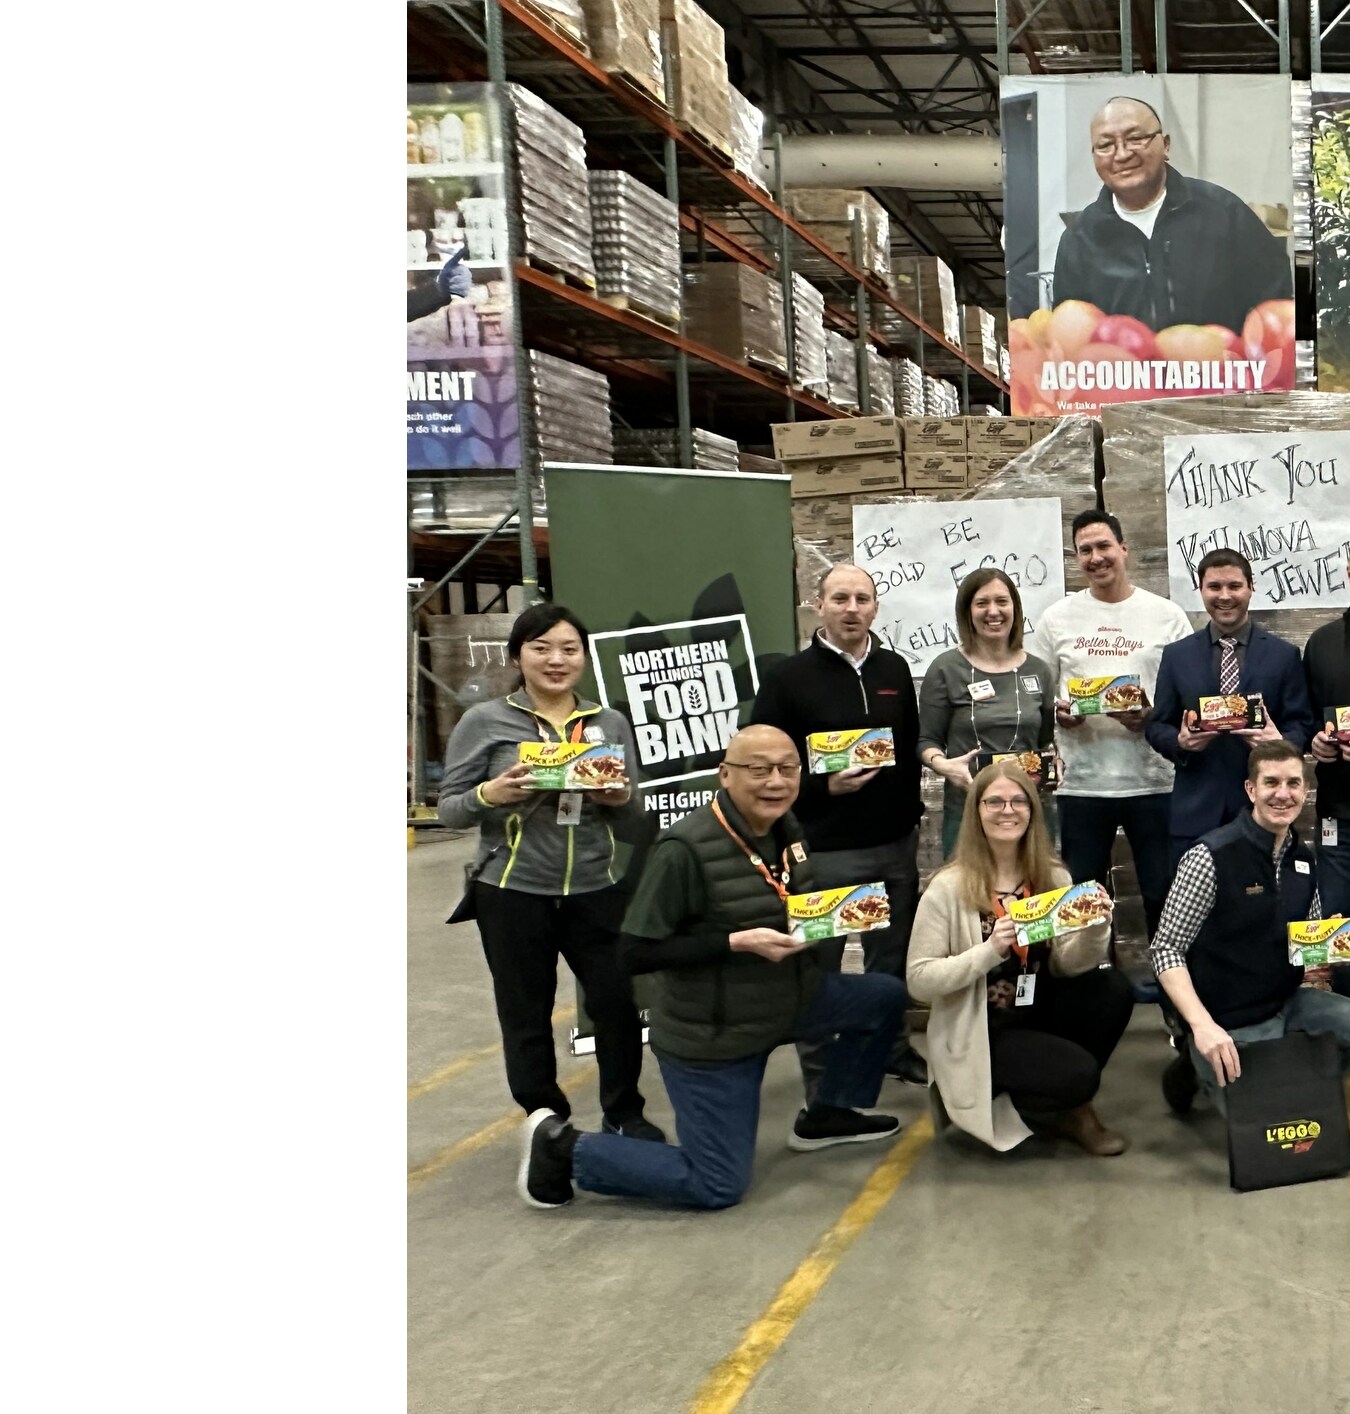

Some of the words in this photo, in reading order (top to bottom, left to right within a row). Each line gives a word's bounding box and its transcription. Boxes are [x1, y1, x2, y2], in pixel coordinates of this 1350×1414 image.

[407, 371, 476, 400] MENT
[1041, 360, 1267, 390] ACCOUNTABILITY
[1167, 446, 1267, 509] THANK
[857, 527, 902, 561] BE
[940, 517, 981, 547] BE
[619, 639, 729, 675] NORTHERN
[1074, 635, 1111, 650] Better
[1112, 635, 1145, 652] Days
[1088, 648, 1129, 657] Promise
[650, 665, 703, 685] ILLINOIS
[624, 661, 738, 726] FOOD
[635, 709, 740, 766] BANK
[1266, 1121, 1321, 1142] L'EGGO
